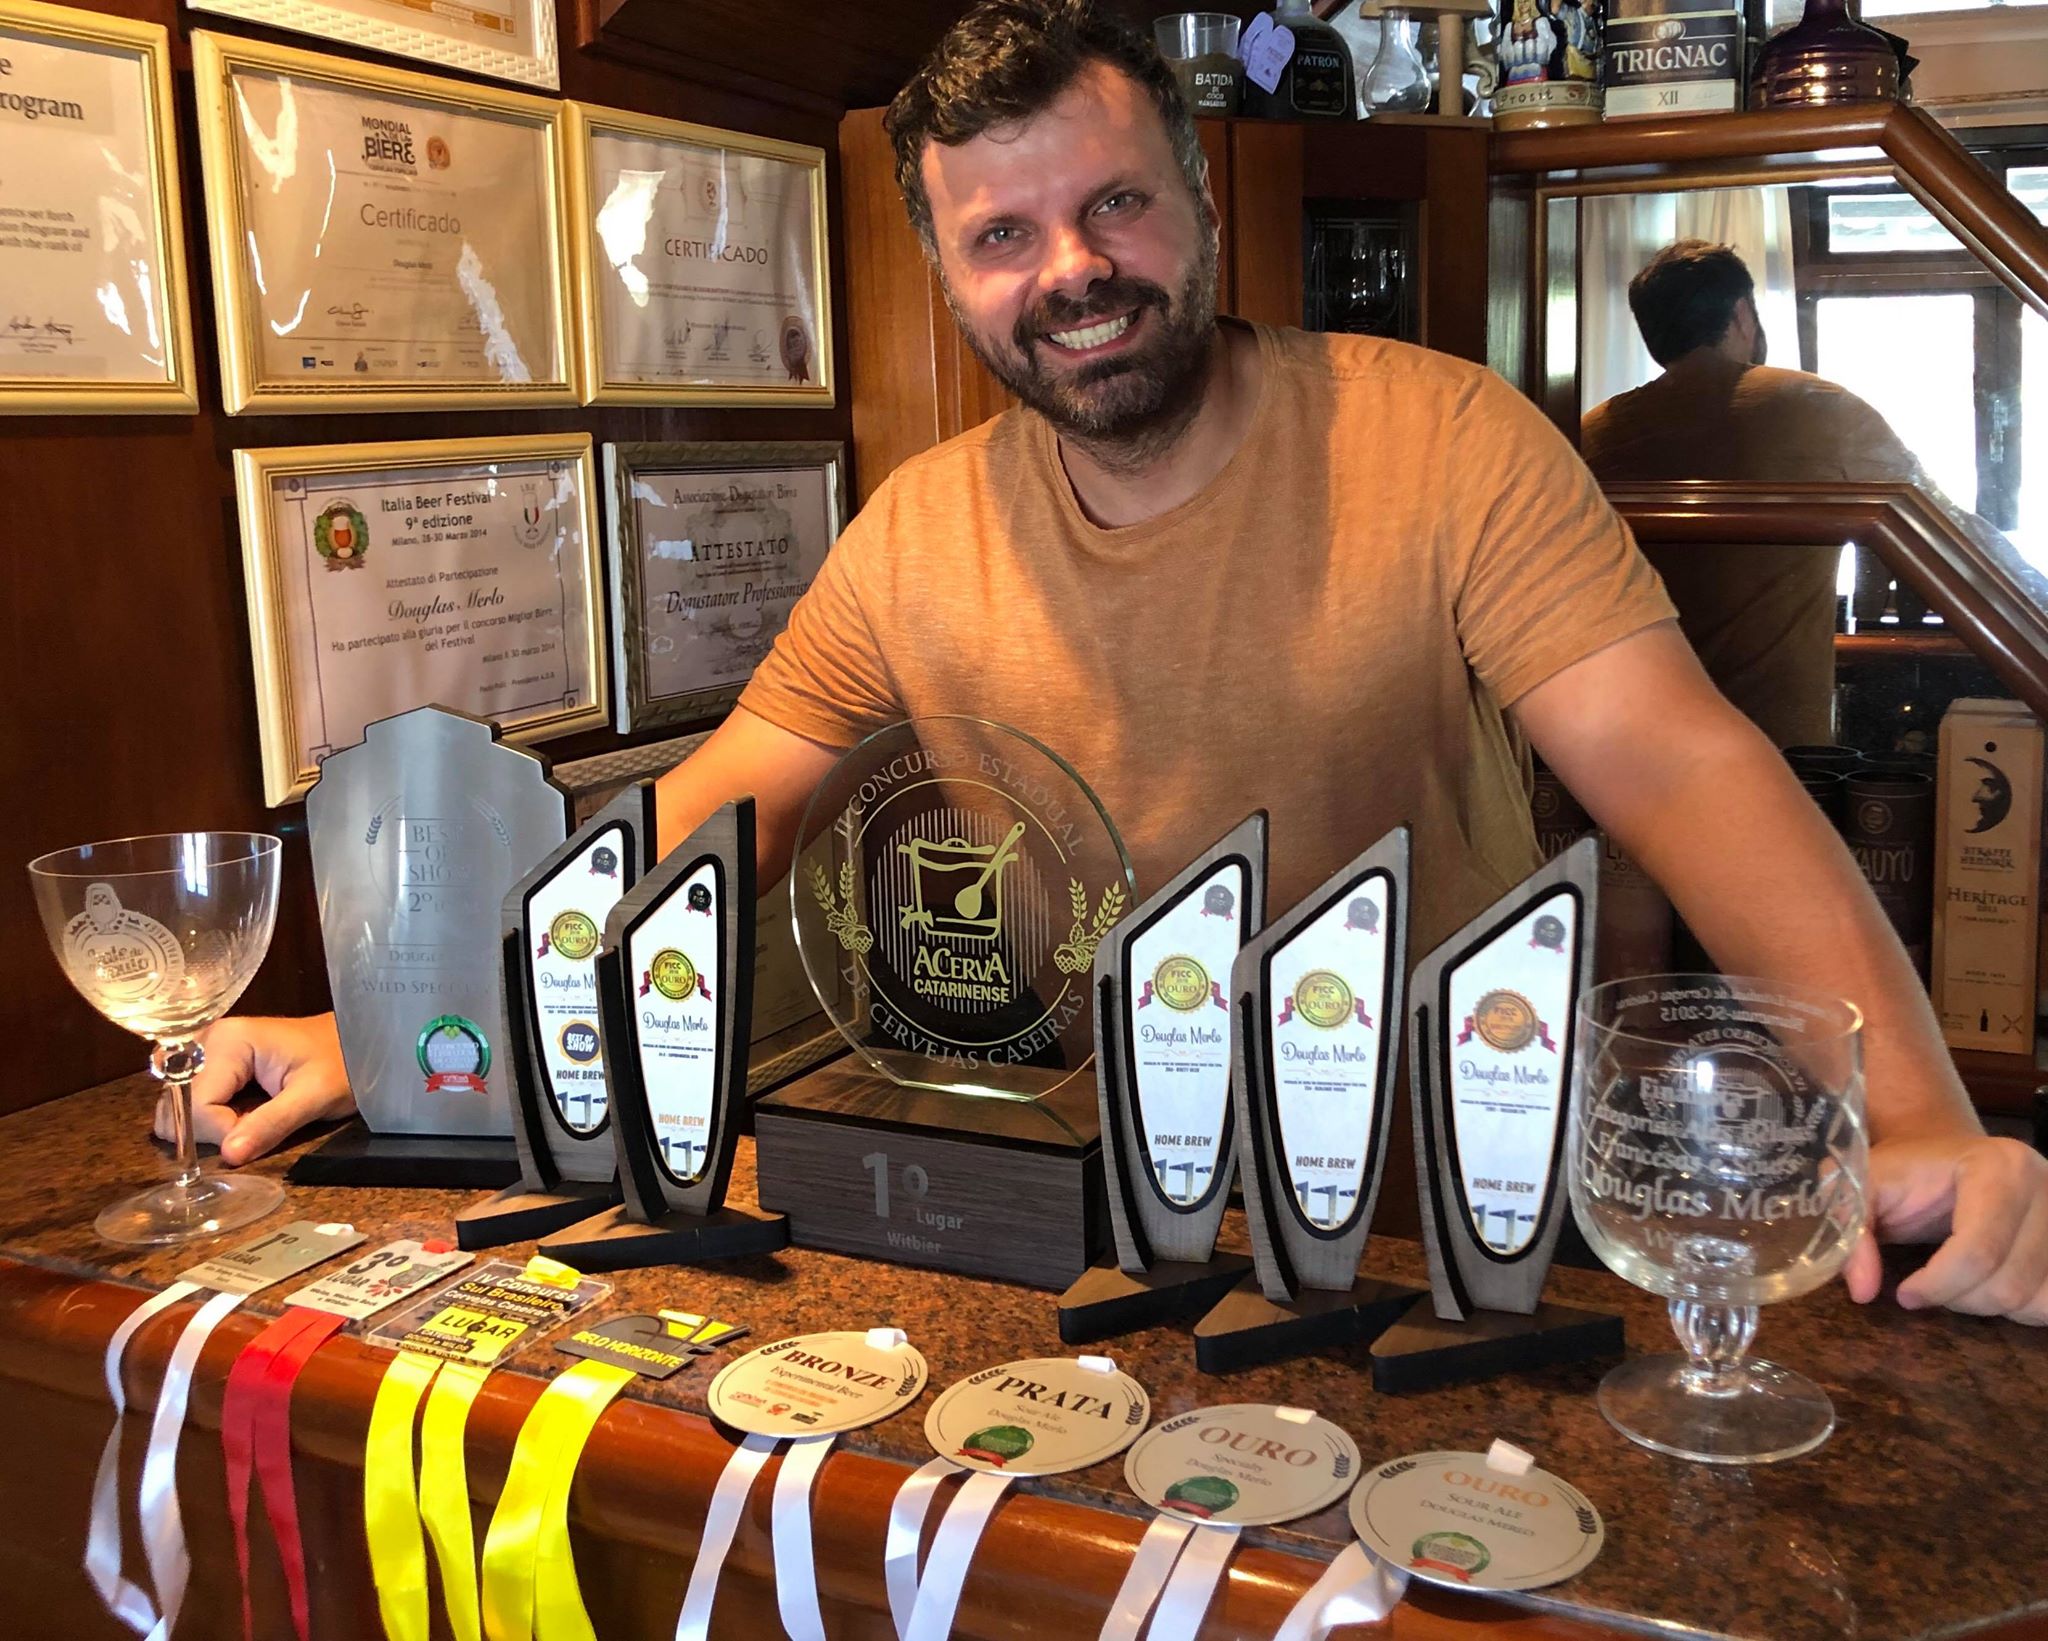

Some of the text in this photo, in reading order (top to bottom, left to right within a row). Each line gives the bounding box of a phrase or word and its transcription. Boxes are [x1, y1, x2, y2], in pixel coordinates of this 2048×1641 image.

[1612, 43, 1728, 75] TRIGNAC
[1195, 73, 1234, 86] BATIDA
[0, 92, 84, 120] rogram
[1657, 90, 1679, 106] XII
[361, 116, 413, 135] MONDIAL
[360, 203, 462, 235] Certificado
[381, 490, 492, 512] Italia Beer Festival
[422, 514, 474, 529] edizione
[690, 537, 789, 563] ATTESTATO
[386, 567, 499, 589] Attestato di Partecipazione
[388, 586, 505, 624] Douglas Merlo
[666, 579, 811, 622] Degustatore Professionist
[331, 641, 345, 651] Ha
[348, 633, 400, 652] partecipato
[446, 624, 461, 635] per
[471, 617, 507, 630] concorso
[425, 634, 476, 651] del Festival
[848, 749, 969, 817] CONCURSO
[979, 753, 1084, 857] ESTADUAL
[664, 962, 682, 970] FICC
[362, 979, 406, 993] WILD
[540, 971, 581, 992] Douglas
[661, 975, 687, 984] OURO
[914, 978, 1011, 1004] CATARINENSE
[1166, 984, 1198, 993] OURO
[642, 1011, 709, 1033] Douglas Merlo
[841, 964, 1086, 1071] DE CERVEJAS CASEIRAS
[567, 1032, 584, 1042] BEST
[567, 1040, 595, 1052] SHOW
[1141, 1024, 1223, 1048] Douglas Merlo
[1280, 1041, 1367, 1066] Douglas Merlo
[556, 1070, 580, 1080] HOME
[1459, 1060, 1549, 1086] Douglas Merlo
[658, 1114, 705, 1127] HOME BREW
[1154, 1134, 1213, 1147] HOME BREW
[1295, 1155, 1356, 1170] HOME BREW
[1472, 1177, 1536, 1194] HOME BREW
[1585, 1157, 1709, 1222] Douglas
[1719, 1179, 1832, 1222] Merlo
[914, 1207, 965, 1232] Lugar
[887, 1231, 942, 1254] Witbier
[458, 1281, 565, 1311] Sul Brasileiro
[473, 1273, 581, 1302] IV Concurso
[443, 1290, 497, 1307] Cervejas
[497, 1300, 552, 1319] Caseiras
[572, 1330, 685, 1368] BELO HORIZONTE
[781, 1349, 895, 1391] BRONZE
[993, 1376, 1113, 1420] PRATA
[1198, 1426, 1319, 1468] OURO
[1443, 1470, 1550, 1508] OURO
